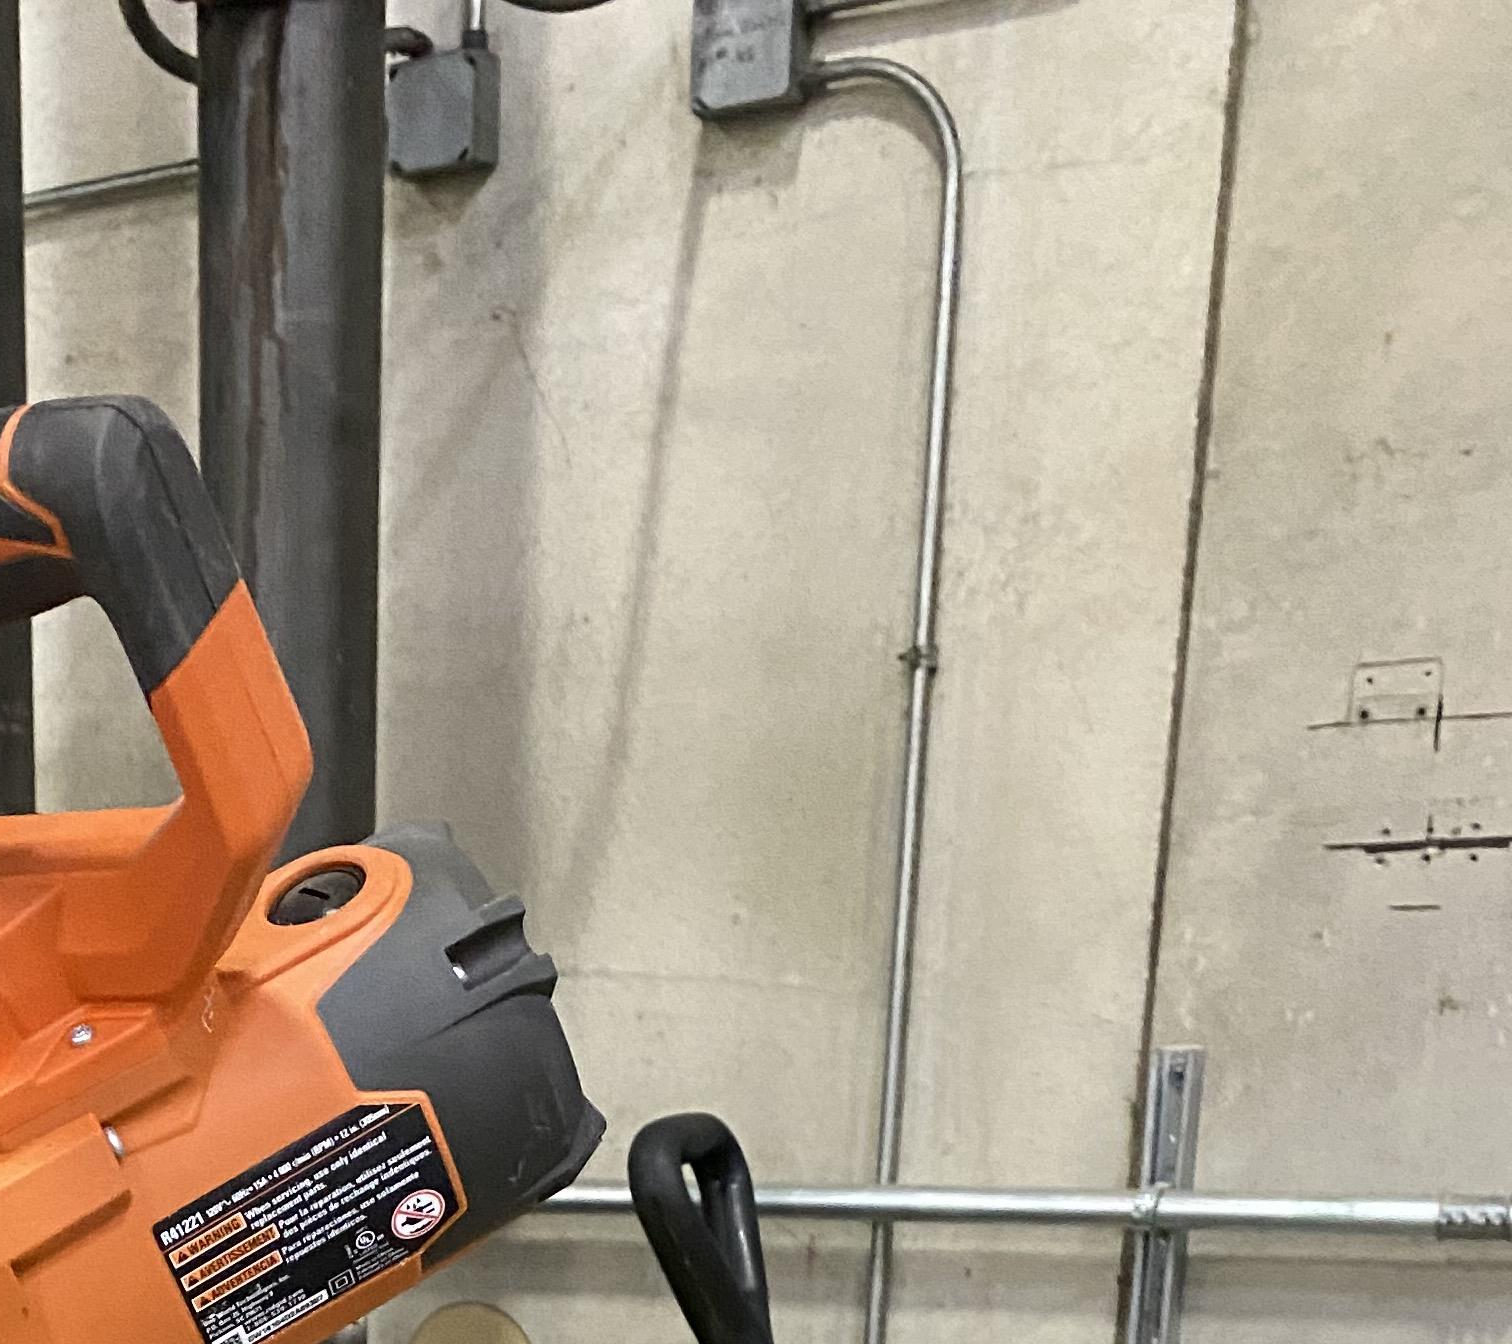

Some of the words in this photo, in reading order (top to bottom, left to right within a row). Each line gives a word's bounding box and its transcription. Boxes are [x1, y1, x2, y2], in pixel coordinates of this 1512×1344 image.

[347, 1130, 387, 1160] identical
[158, 1210, 206, 1246] R41221
[187, 1217, 241, 1255] WARNING
[195, 1227, 276, 1280] AVERTISSEMENT
[210, 1254, 278, 1300] ADVERTENCIA
